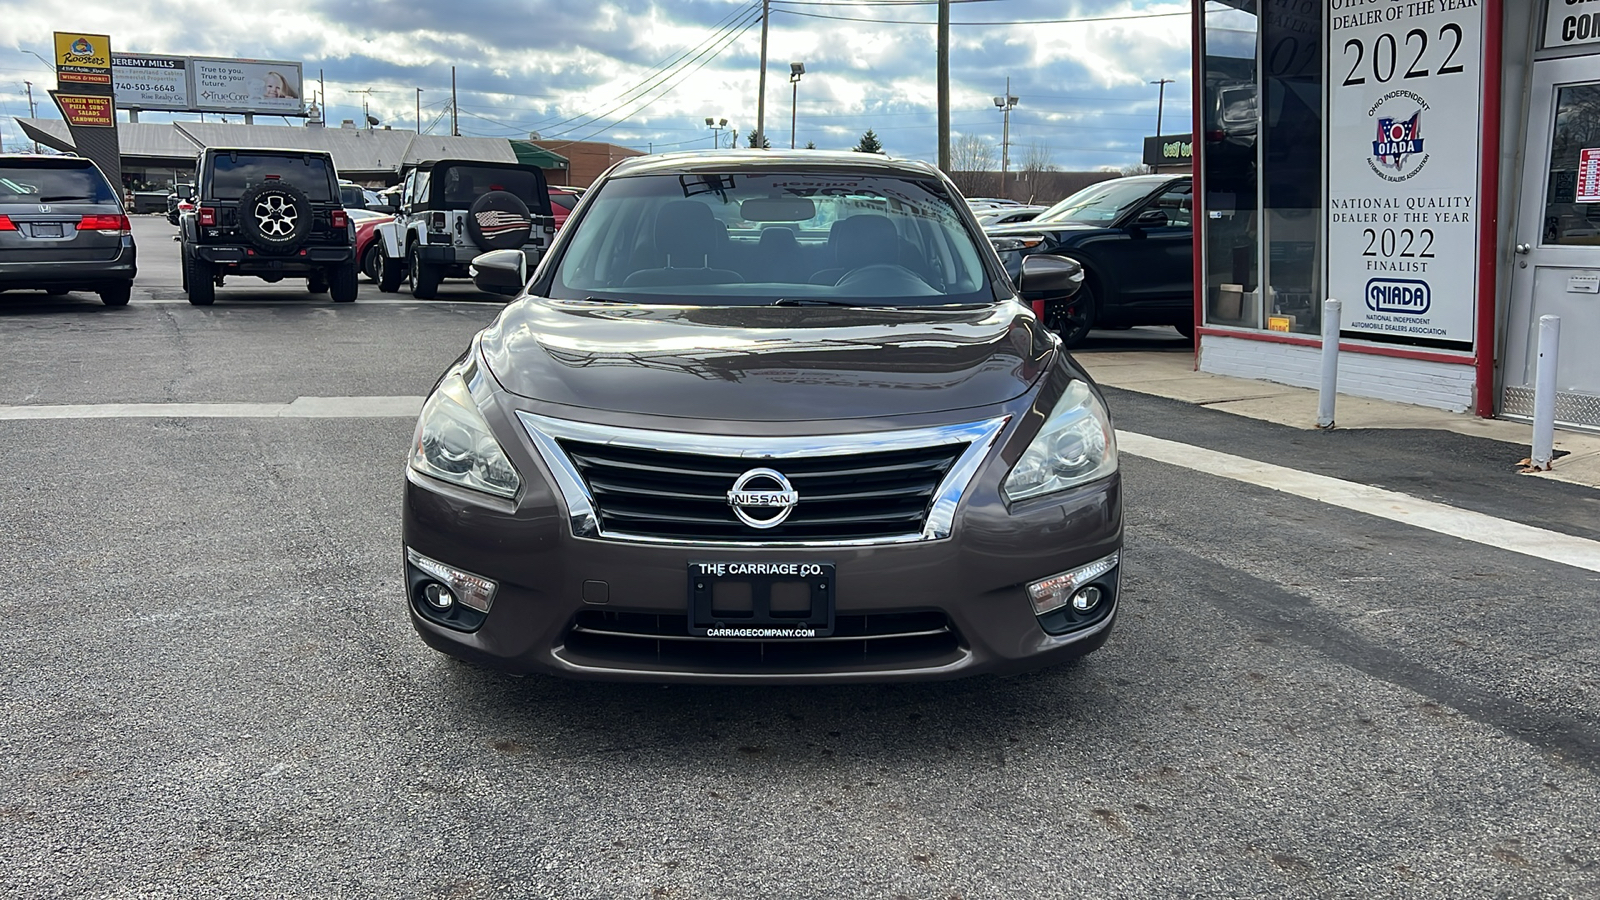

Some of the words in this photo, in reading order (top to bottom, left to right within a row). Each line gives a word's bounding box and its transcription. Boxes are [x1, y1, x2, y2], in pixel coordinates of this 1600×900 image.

[1333, 9, 1383, 30] DEALER
[1386, 6, 1403, 21] OF
[1407, 0, 1435, 17] THE
[62, 52, 105, 65] Roosters
[1342, 22, 1464, 86] 2022
[112, 58, 146, 66] JEREMY
[149, 60, 175, 68] MILLS
[115, 82, 175, 92] 740-503-6648
[155, 94, 173, 102] Realty
[210, 91, 248, 101] TrueCore
[1368, 98, 1384, 117] OHIO
[1383, 89, 1431, 112] INDEPENDENT
[1379, 141, 1415, 154] OIADA
[1366, 157, 1388, 181] AUTOMOBILE
[1406, 153, 1430, 180] ASSOCIATION
[1331, 198, 1400, 209] NATIONAL
[1406, 197, 1472, 210] QUALITY
[1333, 213, 1378, 222] DEALER
[1383, 213, 1399, 222] OF
[1404, 213, 1429, 222] THE
[1434, 212, 1470, 222] YEAR
[1362, 228, 1435, 258] 2022
[1367, 260, 1428, 272] FINALIST
[1370, 286, 1424, 307] NIADA
[1366, 314, 1392, 322] NATIONAL
[1393, 316, 1430, 325] INDEPENDENT
[1351, 322, 1384, 330] AUTOMOBILE
[1385, 324, 1408, 333] DEALERS
[1408, 326, 1447, 335] ASSOCIATION
[735, 494, 791, 504] NISSAN
[699, 563, 725, 575] THE
[728, 563, 798, 575] CARRIAGE
[801, 563, 824, 576] CO.
[707, 628, 815, 638] CARRIAGECOMPANY.COM
